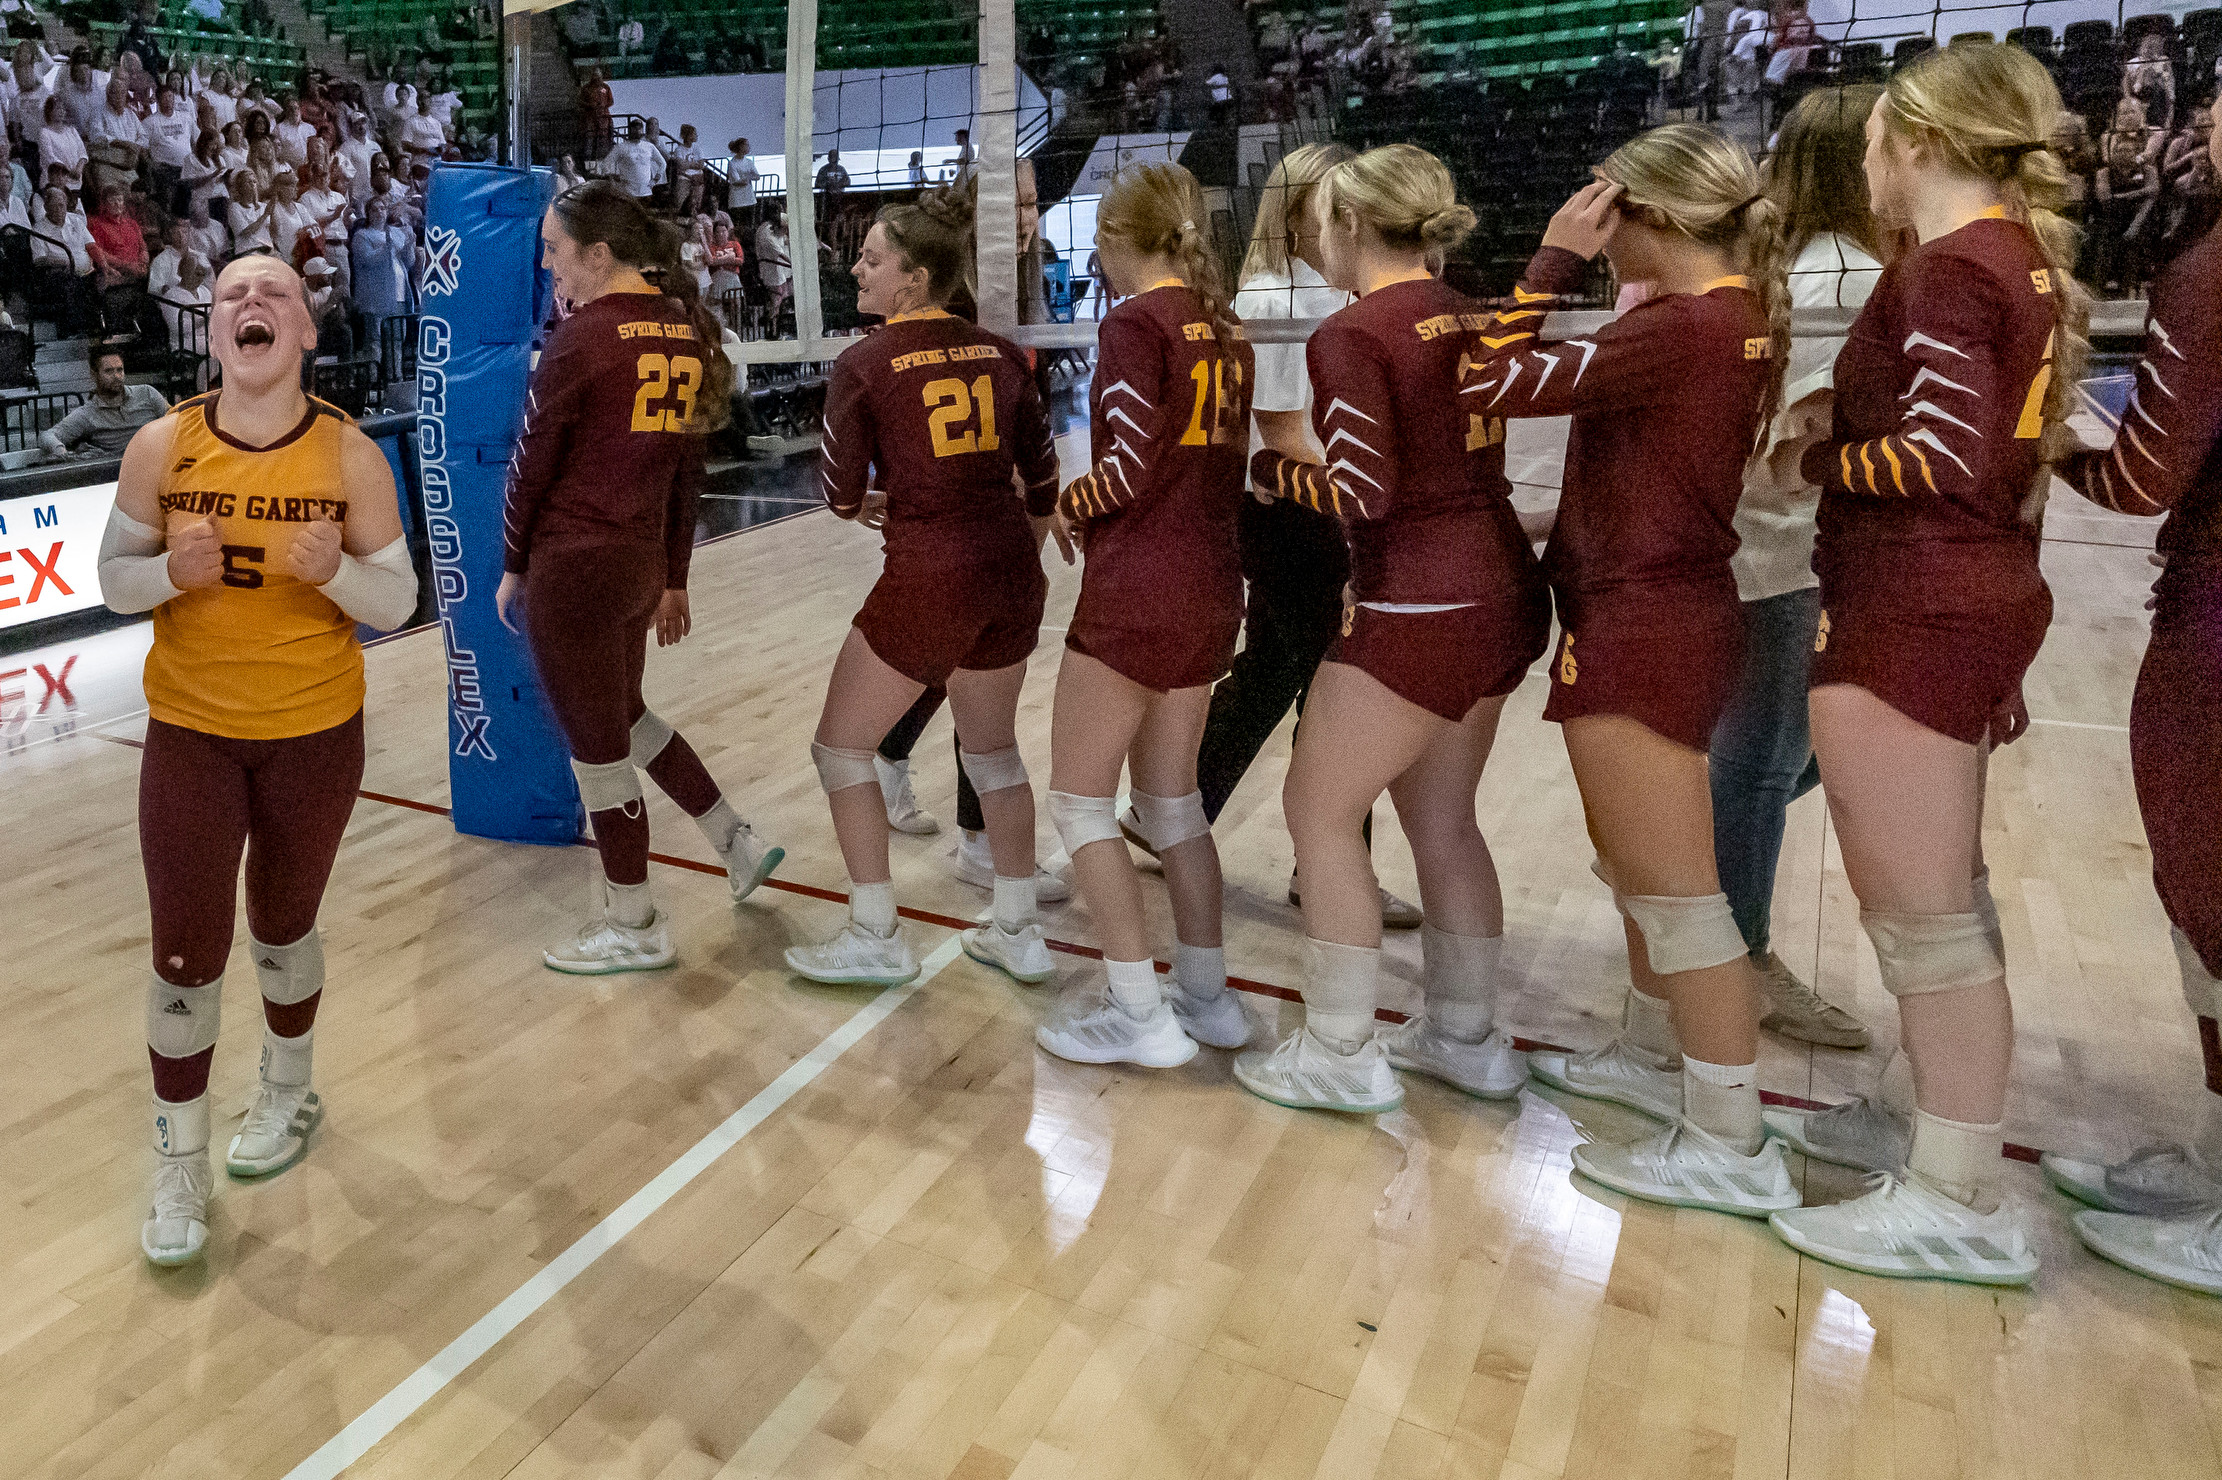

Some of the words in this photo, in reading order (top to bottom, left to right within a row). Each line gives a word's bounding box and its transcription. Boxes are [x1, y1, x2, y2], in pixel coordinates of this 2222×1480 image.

[617, 321, 664, 340] SPRING
[890, 349, 948, 373] SPRING
[948, 344, 1003, 362] GARDEN
[631, 353, 703, 434] 23
[922, 374, 1000, 458] 21
[221, 544, 265, 590] 5
